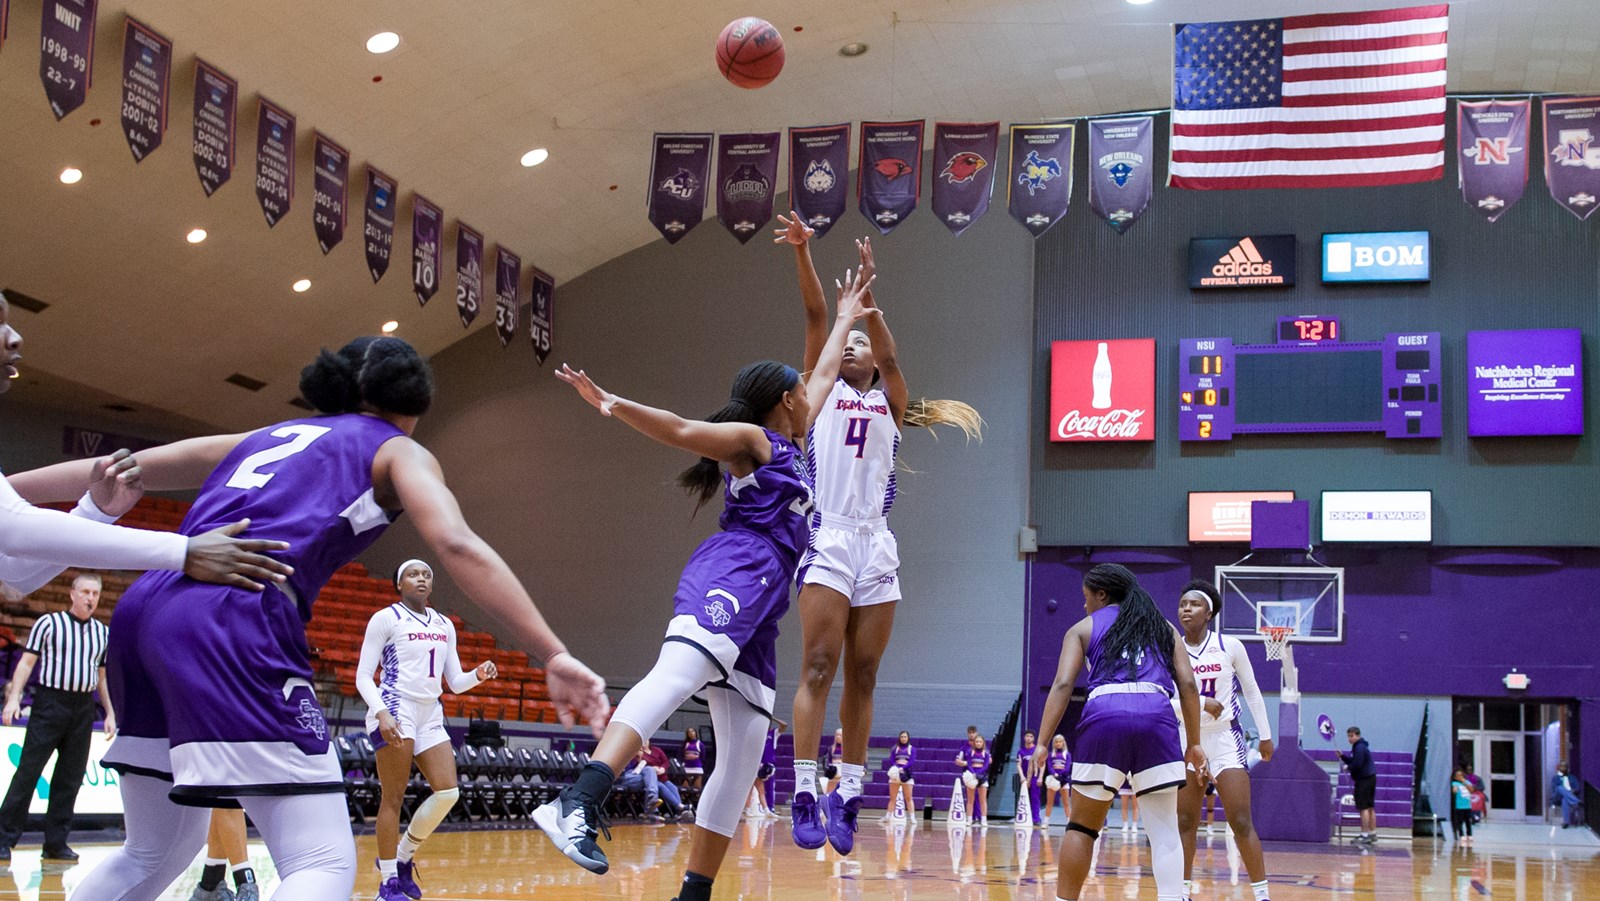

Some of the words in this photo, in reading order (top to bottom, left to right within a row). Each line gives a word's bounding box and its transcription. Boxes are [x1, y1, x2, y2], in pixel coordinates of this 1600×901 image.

[56, 3, 81, 32] WNIT
[42, 36, 86, 72] 1998-99
[47, 66, 76, 90] 22-7
[129, 70, 159, 92] CHAMPION
[127, 91, 156, 115] DOBIN
[122, 103, 158, 133] 2001-02
[198, 130, 224, 151] DOBIN
[1478, 140, 1506, 162] N
[1568, 142, 1584, 160] N
[193, 140, 227, 169] 2002-03
[1099, 153, 1114, 166] NEW
[1114, 152, 1143, 164] ORLEANS
[1029, 167, 1050, 179] M
[257, 175, 287, 201] 2003-04
[663, 179, 693, 198] ACU
[314, 189, 341, 215] 2003-04
[316, 212, 337, 231] 24-7
[1355, 245, 1423, 267] BOM
[414, 261, 434, 289] 10
[1212, 262, 1272, 276] adidas
[1238, 276, 1283, 284] OUTFITTER
[457, 284, 477, 312] 25
[496, 304, 514, 332] 33
[531, 324, 549, 351] 45
[1295, 320, 1336, 340] 7:21
[1398, 335, 1428, 346] GUEST
[1197, 341, 1215, 350] NSU
[1203, 356, 1222, 374] 11
[1475, 365, 1533, 378] Natchitoches
[1534, 364, 1574, 379] Regional
[1493, 378, 1527, 388] Medical
[1528, 377, 1557, 388] Center
[834, 399, 888, 416] DEMONS
[1204, 389, 1216, 406] 0
[1058, 408, 1145, 438] Coca-Cola
[1200, 421, 1211, 438] 2
[844, 417, 872, 459] 4
[225, 424, 332, 490] 2
[1329, 511, 1367, 520] DEMON
[1372, 511, 1426, 520] REWARDS
[408, 632, 448, 643] DEMONS
[428, 647, 436, 678] 1
[1192, 664, 1222, 673] MONS
[894, 791, 906, 819] NSU
[952, 793, 964, 822] NSU
